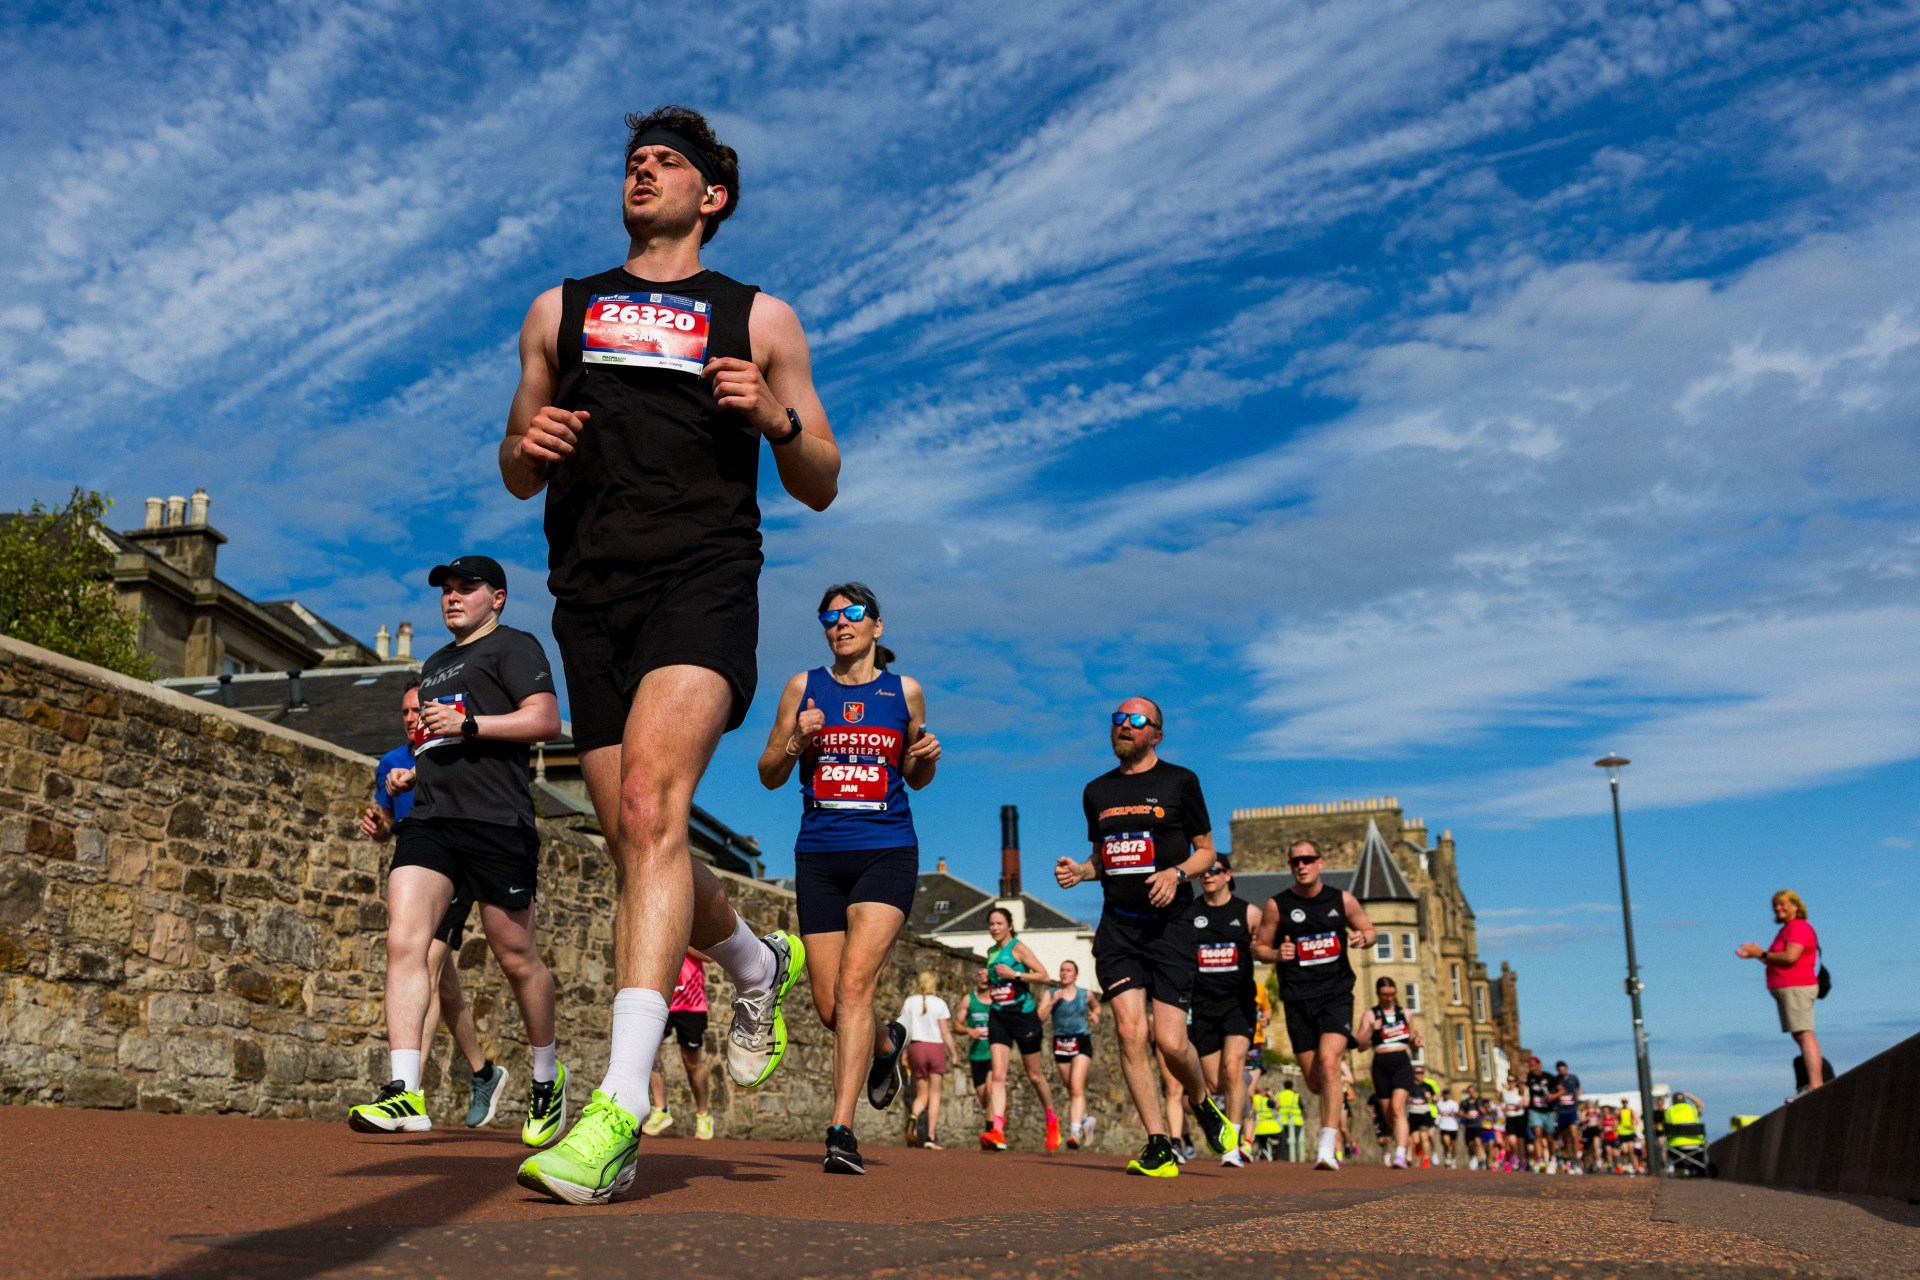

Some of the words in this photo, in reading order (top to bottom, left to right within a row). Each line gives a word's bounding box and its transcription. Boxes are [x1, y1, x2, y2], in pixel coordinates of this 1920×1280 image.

[600, 304, 696, 331] 26320
[812, 733, 896, 748] CHEPSTOW
[823, 747, 881, 756] HARRIERS
[821, 765, 880, 782] 26745
[840, 784, 858, 793] JAN
[1106, 840, 1146, 855] 26873
